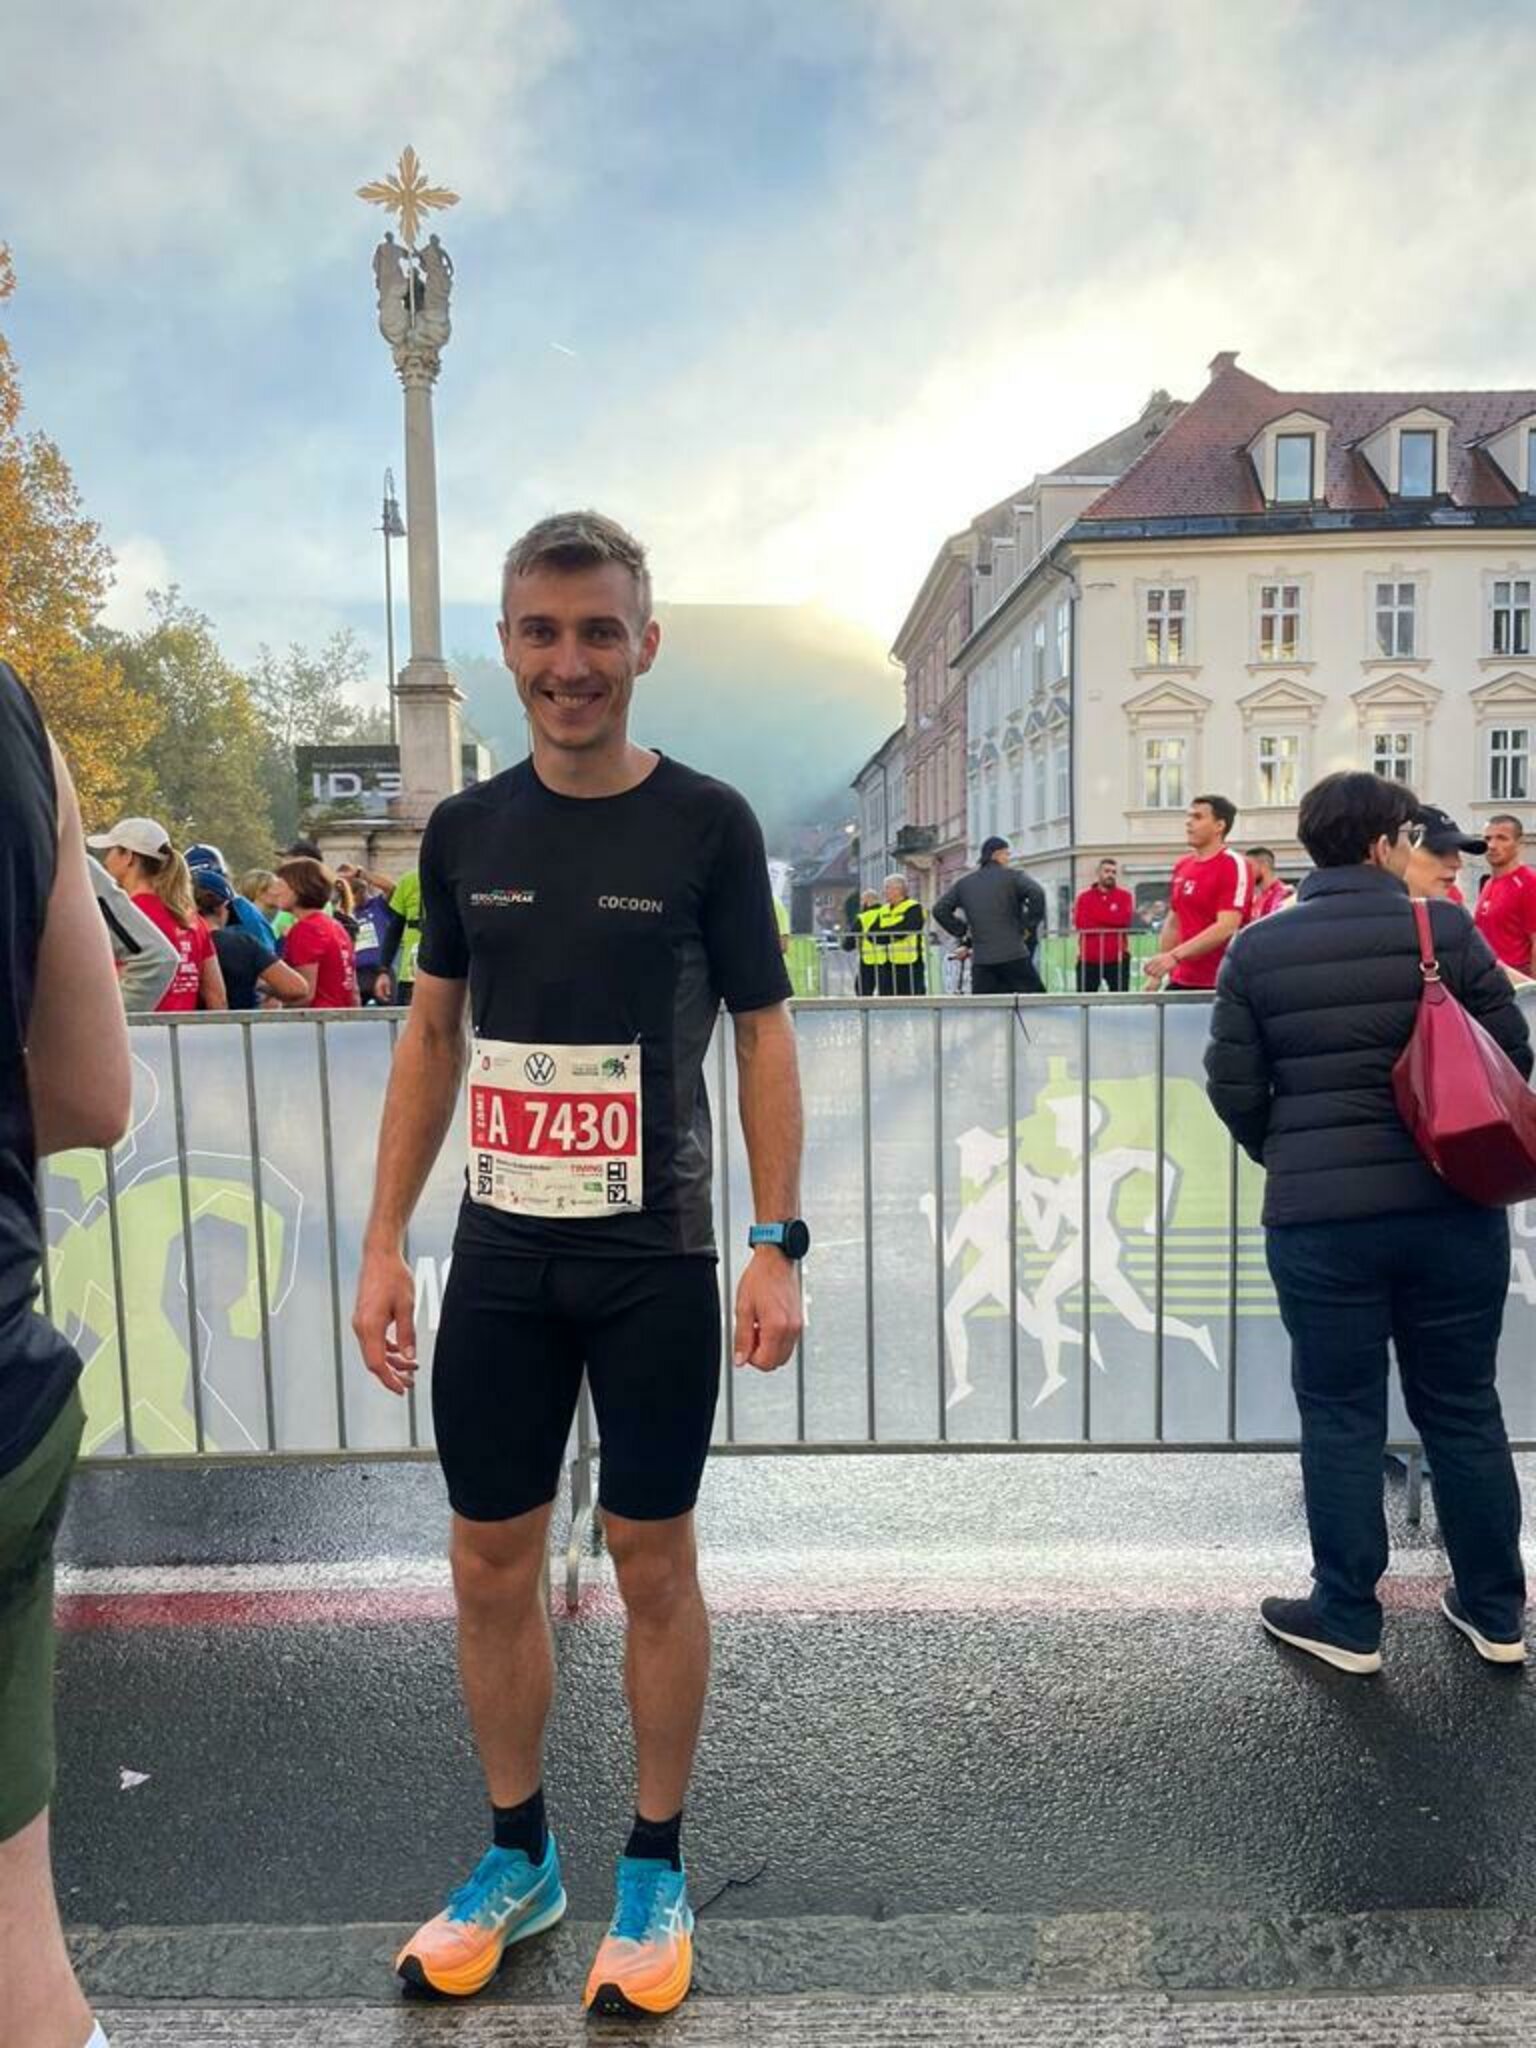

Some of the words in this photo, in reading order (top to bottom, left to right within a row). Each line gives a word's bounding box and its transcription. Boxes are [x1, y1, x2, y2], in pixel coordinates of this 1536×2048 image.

[598, 895, 663, 913] COCOON
[488, 1095, 509, 1146] A
[524, 1101, 629, 1151] 7430
